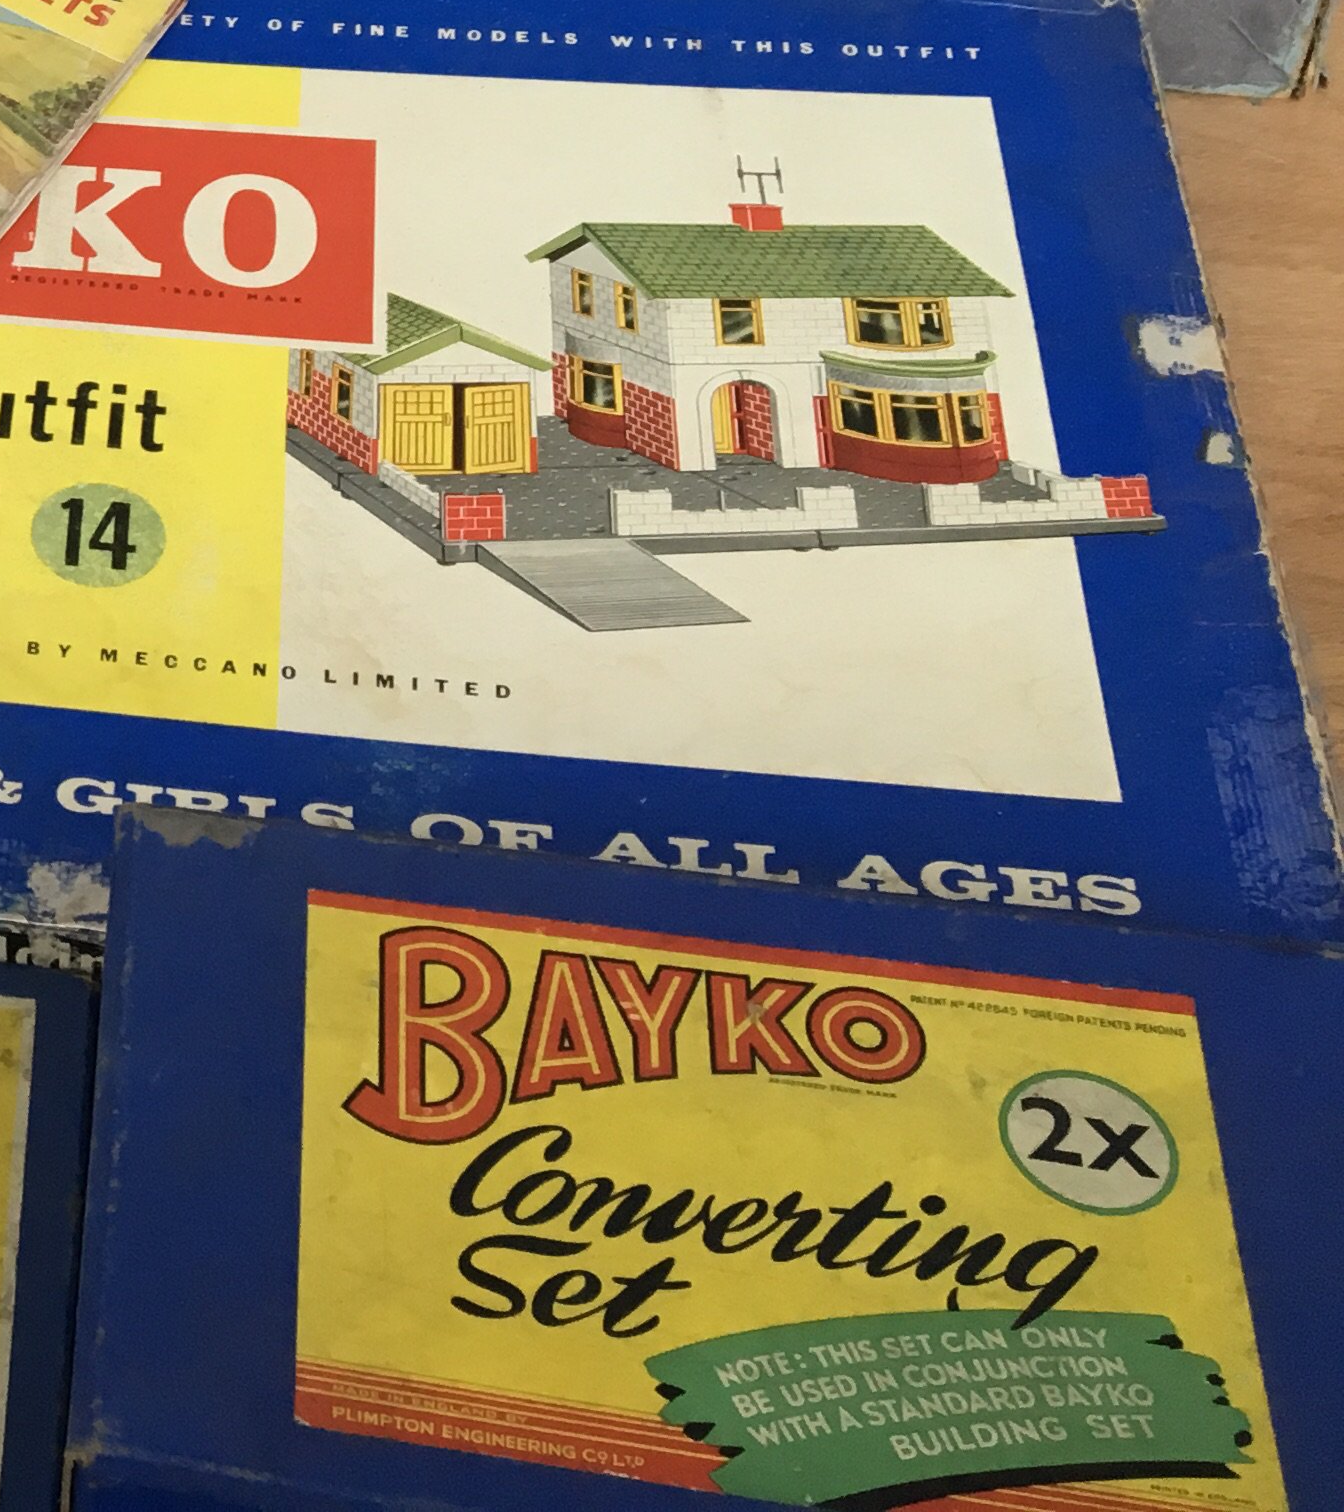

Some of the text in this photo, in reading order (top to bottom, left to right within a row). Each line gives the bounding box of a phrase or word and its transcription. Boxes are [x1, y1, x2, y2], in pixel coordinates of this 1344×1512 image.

[267, 19, 304, 32] OF
[332, 22, 409, 38] FINE
[437, 28, 578, 45] MODELS
[611, 35, 703, 51] WITH
[731, 39, 814, 55] THIS
[842, 43, 980, 61] OUTFIT
[11, 274, 303, 304] REGISTERED TRADE MARK
[61, 498, 136, 570] 14
[28, 641, 73, 659] BY
[100, 647, 297, 681] MECCANO
[324, 669, 513, 700] LIMITED
[412, 813, 552, 851] OF
[595, 831, 802, 885] ALL
[838, 854, 1143, 917] AGES
[342, 926, 928, 1145] BAYKO
[448, 1124, 1098, 1330] Converting
[450, 1235, 691, 1337] Set
[332, 1406, 576, 1459] PLIMPTON ENGINEERING
